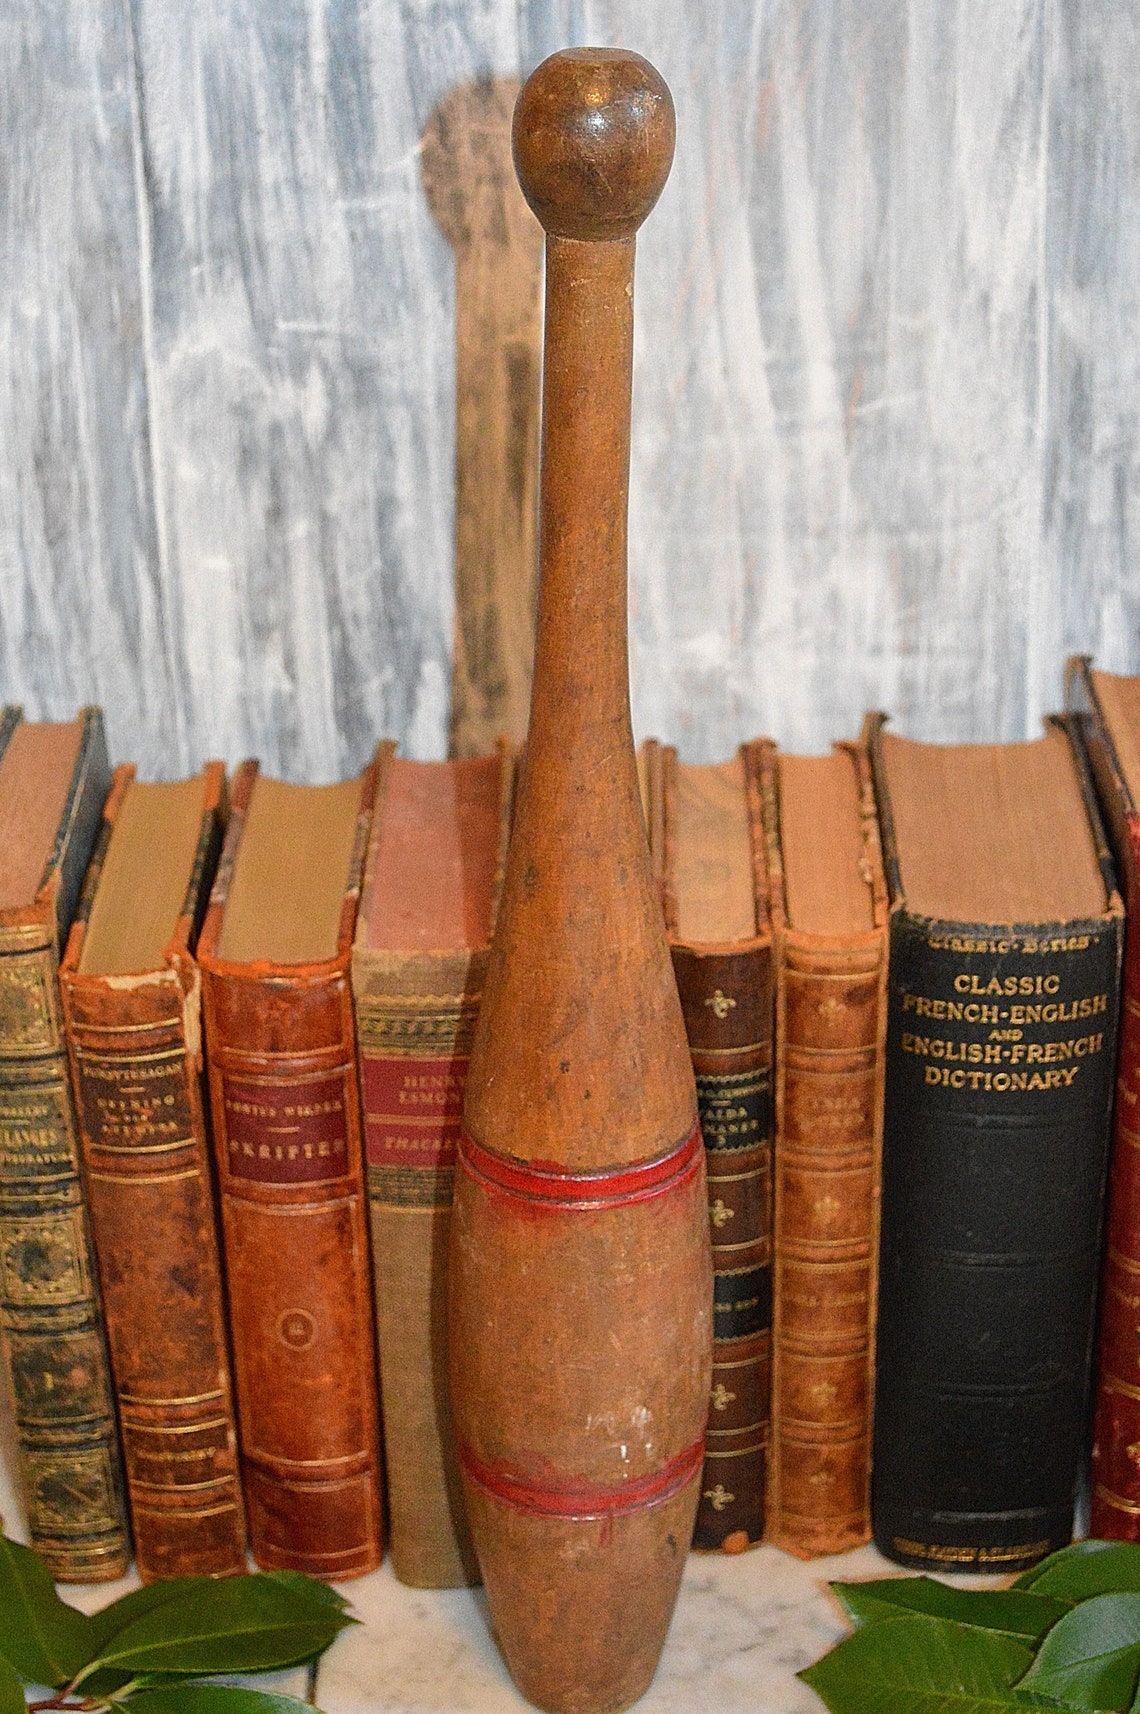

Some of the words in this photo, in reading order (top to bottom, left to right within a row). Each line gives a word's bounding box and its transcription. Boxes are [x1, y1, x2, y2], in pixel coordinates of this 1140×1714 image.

[954, 974, 1060, 996] CLASSIC
[902, 993, 1108, 1025] FRENCH-ENGLISH
[987, 1028, 1024, 1042] AND
[901, 1032, 1104, 1065] ENGLISH-FRENCH
[924, 1065, 1080, 1092] DICTIONARY
[400, 1091, 462, 1106] ESMON
